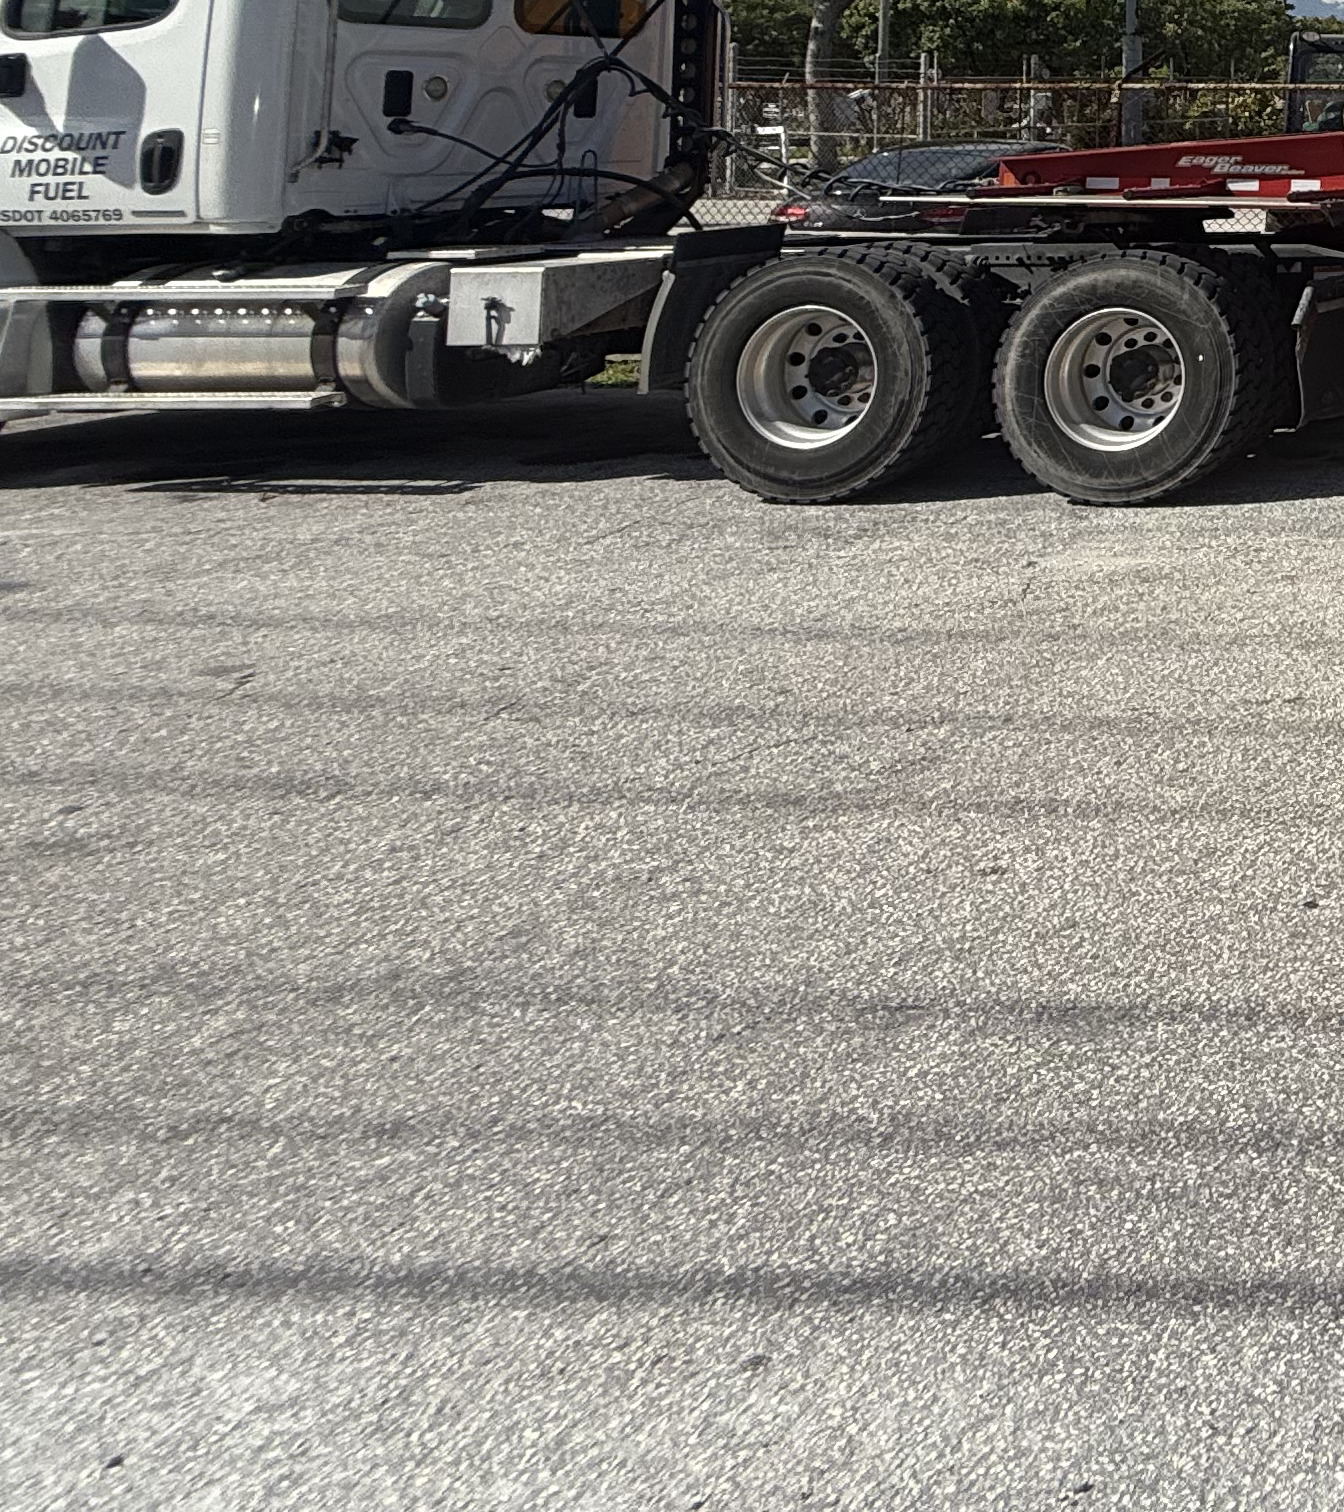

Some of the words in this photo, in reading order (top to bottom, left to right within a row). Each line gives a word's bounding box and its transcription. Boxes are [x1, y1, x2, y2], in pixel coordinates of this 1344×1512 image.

[0, 130, 127, 154] DISCOUNT
[10, 155, 110, 178] MOBILE
[1175, 155, 1243, 168] Eager
[1211, 163, 1290, 175] Beaver
[28, 181, 90, 202] FUEL
[49, 209, 123, 223] 4065769
